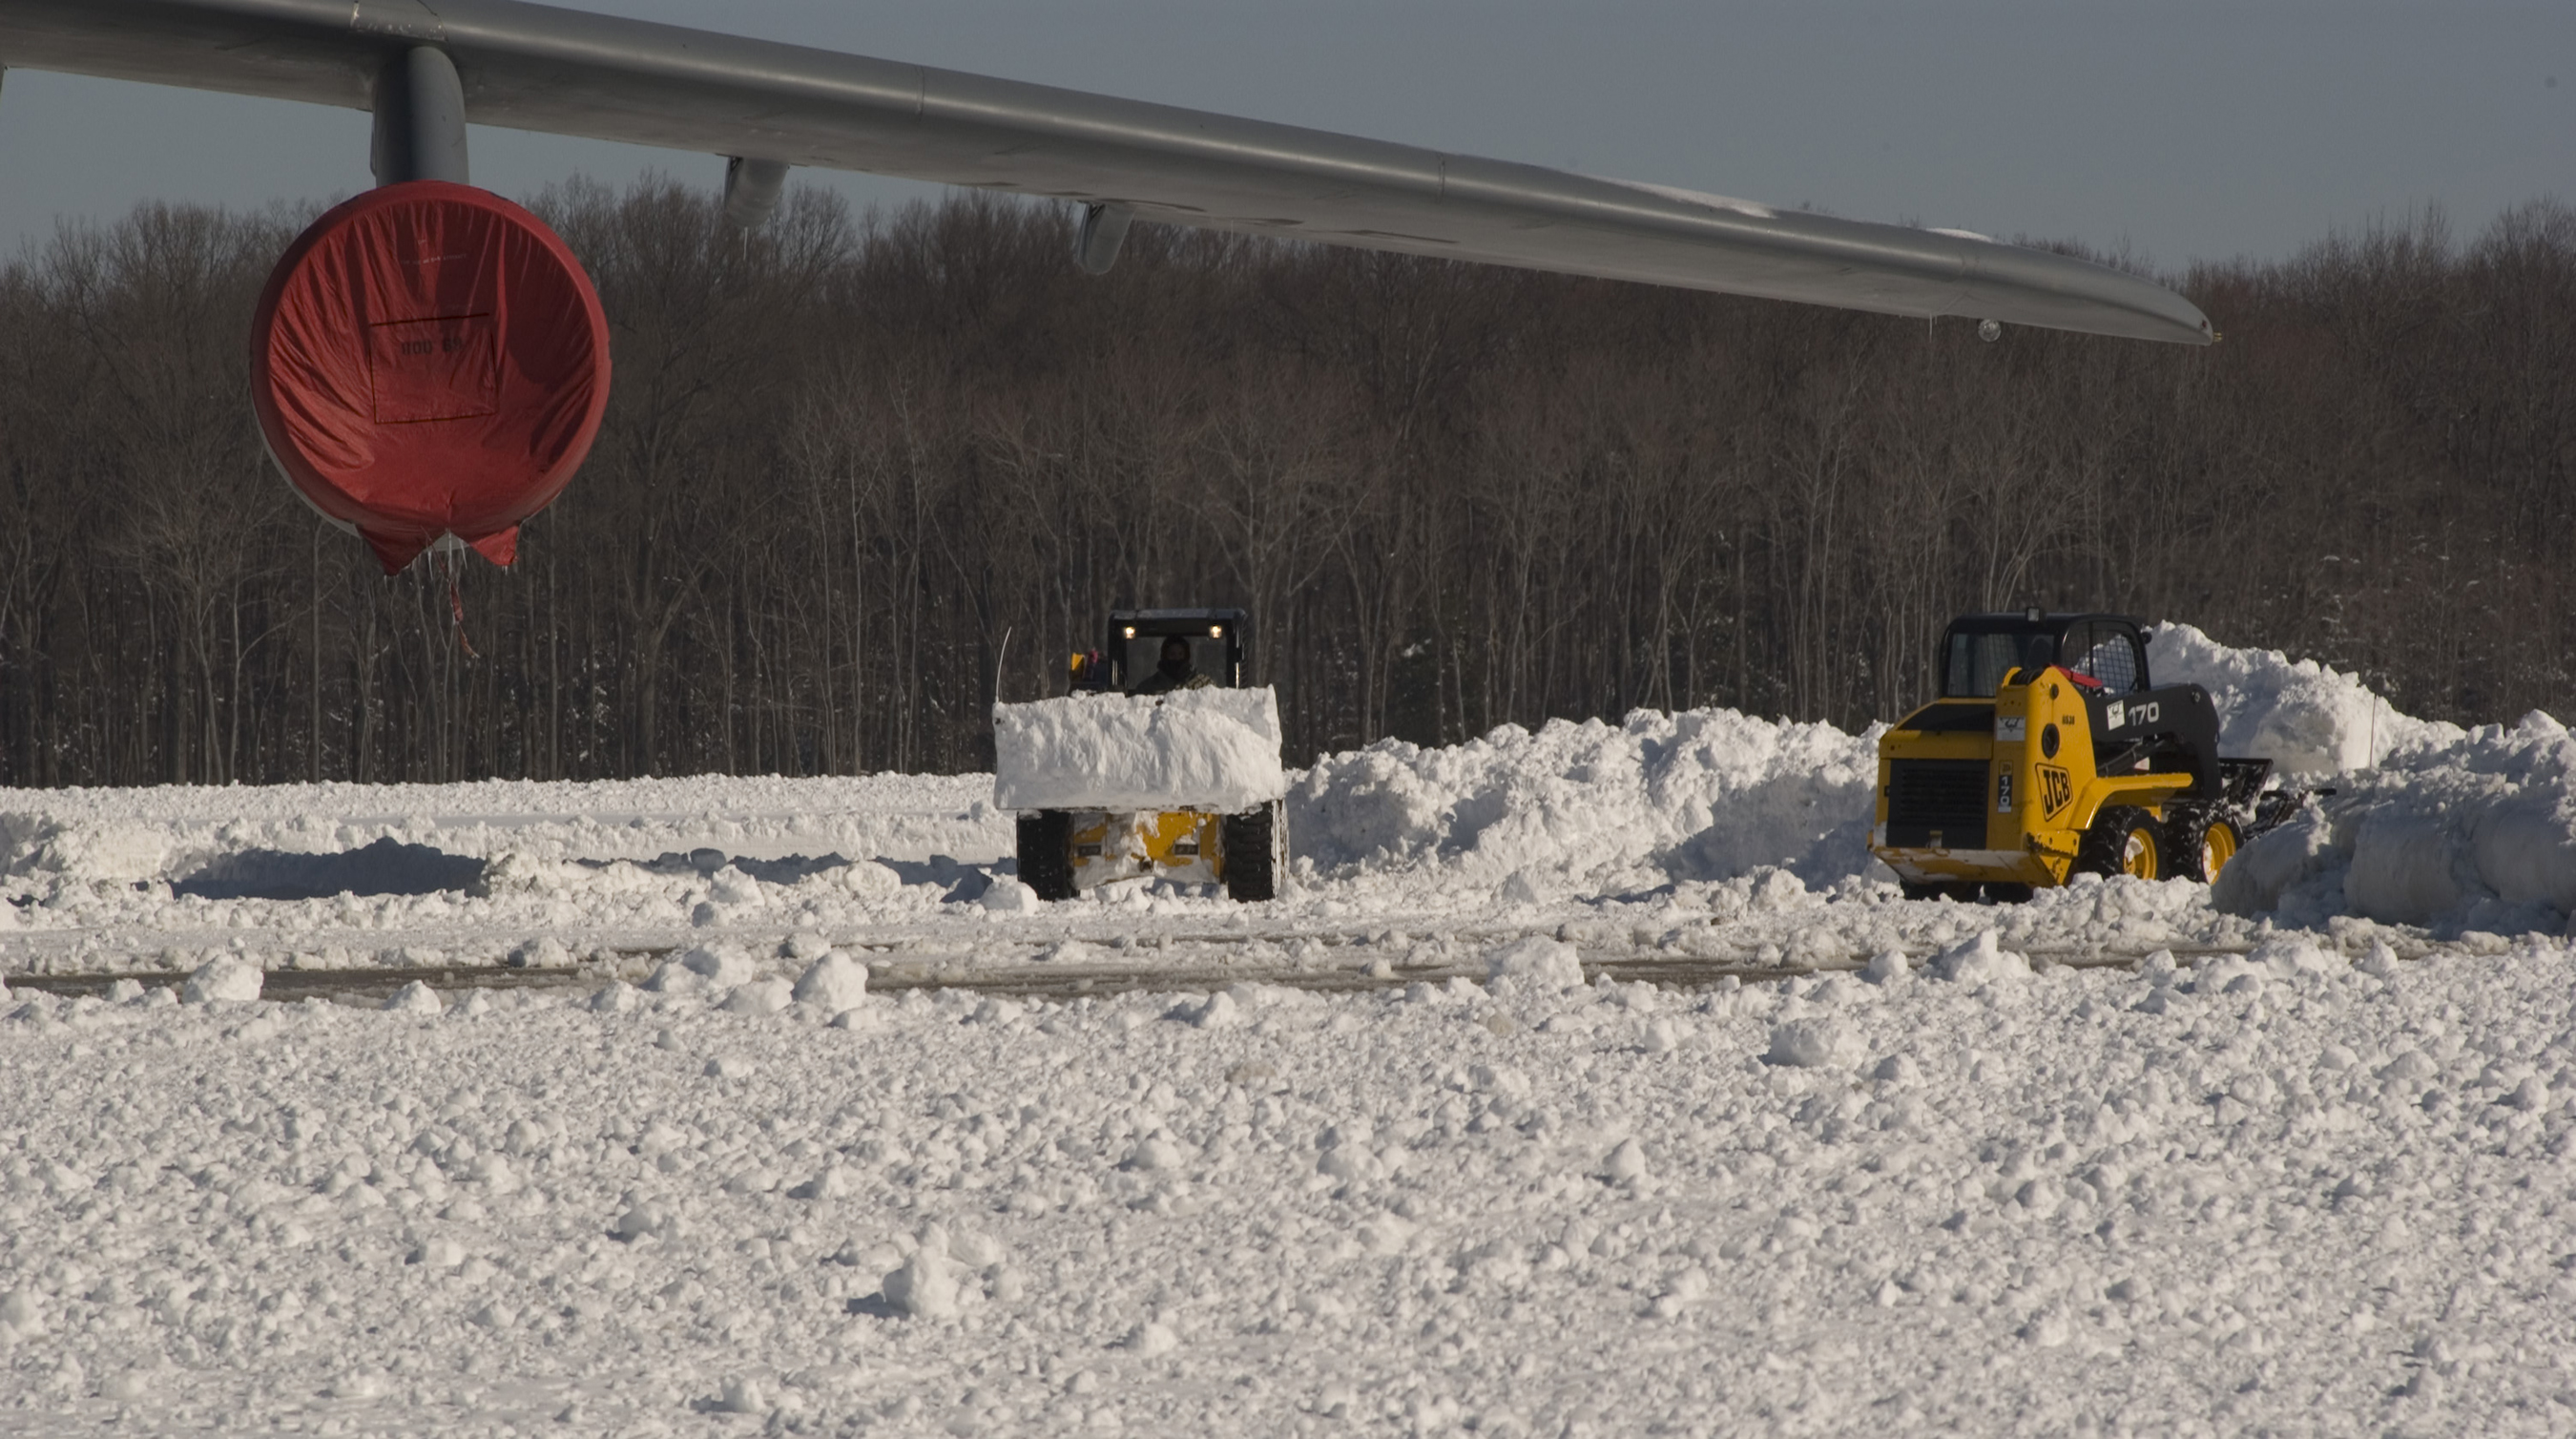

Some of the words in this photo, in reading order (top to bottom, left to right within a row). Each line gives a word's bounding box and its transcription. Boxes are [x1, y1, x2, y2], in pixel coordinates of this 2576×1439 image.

[2128, 701, 2159, 726] 170
[2000, 776, 2010, 805] 170
[2043, 769, 2070, 814] JCB
